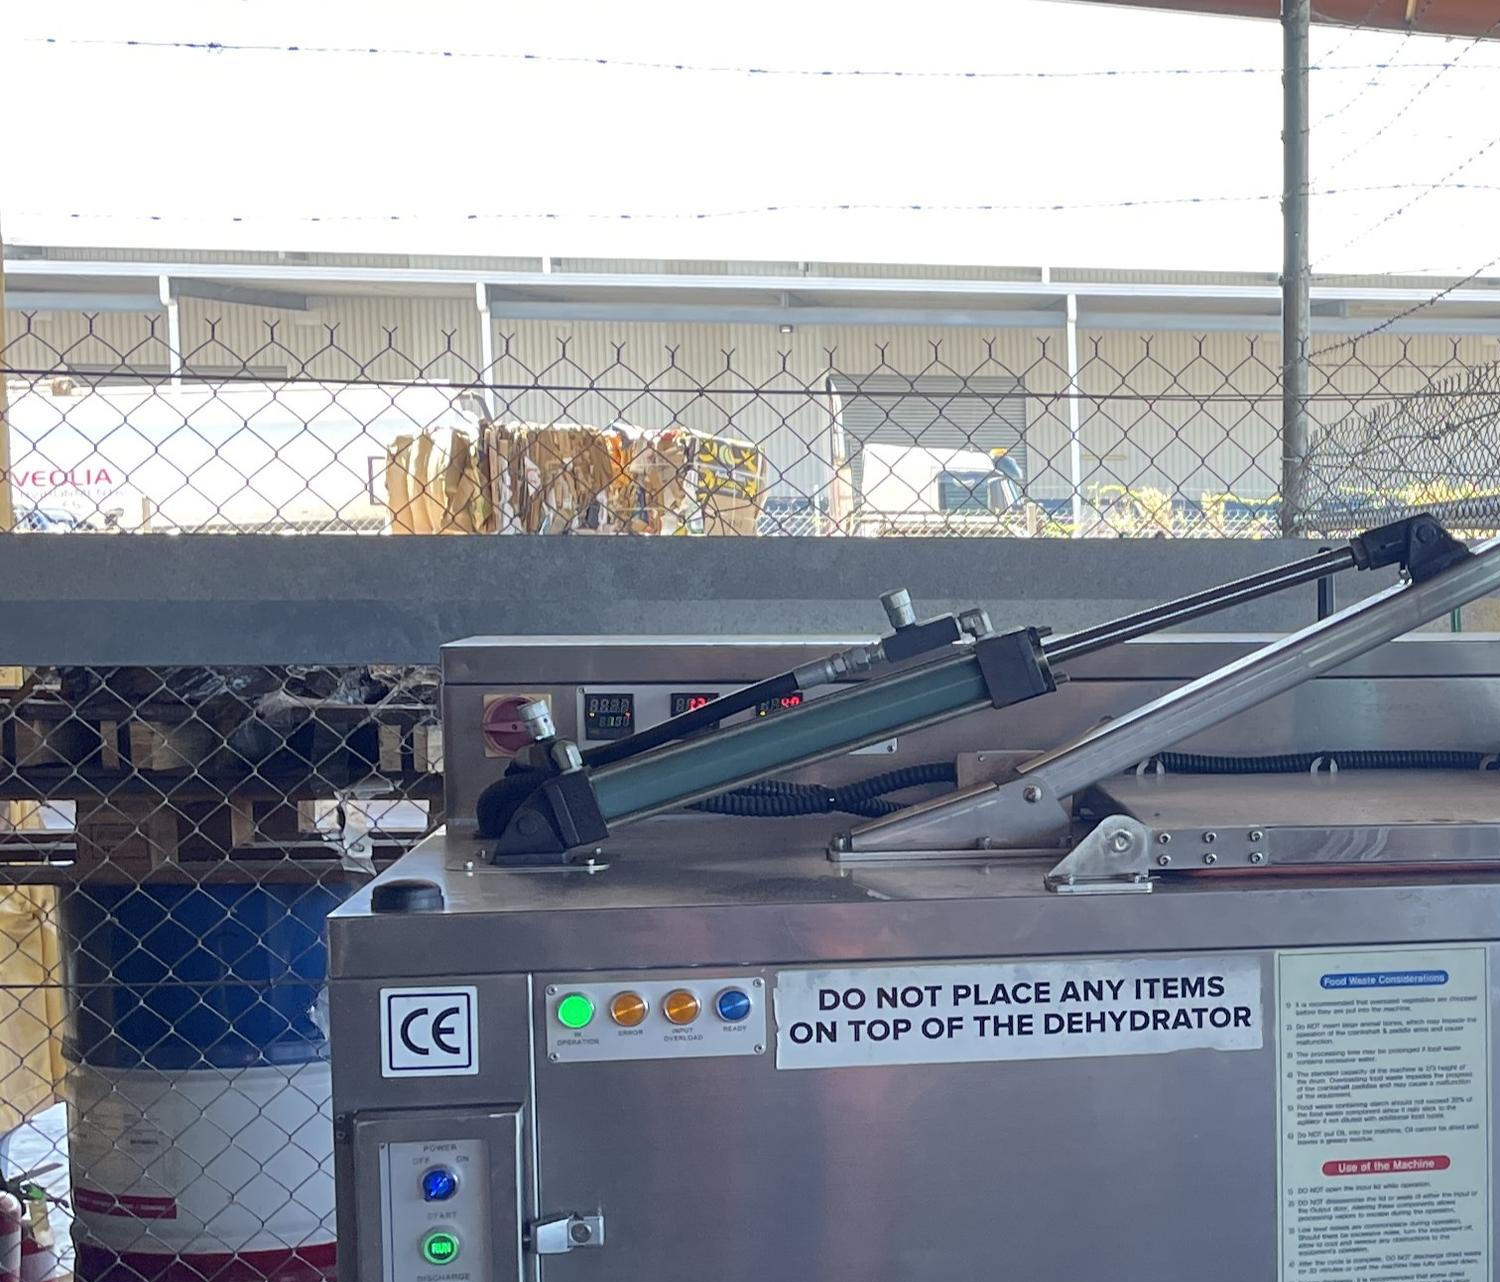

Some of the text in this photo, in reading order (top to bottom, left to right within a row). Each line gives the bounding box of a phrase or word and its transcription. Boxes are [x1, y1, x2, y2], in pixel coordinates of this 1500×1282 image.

[12, 469, 112, 487] VEOLIA
[1324, 974, 1445, 987] Food Waste Considerations
[818, 976, 1225, 1011] DO NOT PLACE ANY ITEMS
[400, 1006, 460, 1056] CE
[789, 1006, 1251, 1044] ON TOP OF THE DEHYDRATOR
[557, 1038, 600, 1047] OPERATION
[423, 1144, 456, 1152] POWER
[1338, 1159, 1434, 1173] Use of the Machine
[427, 1211, 457, 1219] START
[431, 1242, 450, 1254] RUN
[417, 1273, 470, 1282] DISCHARGE
